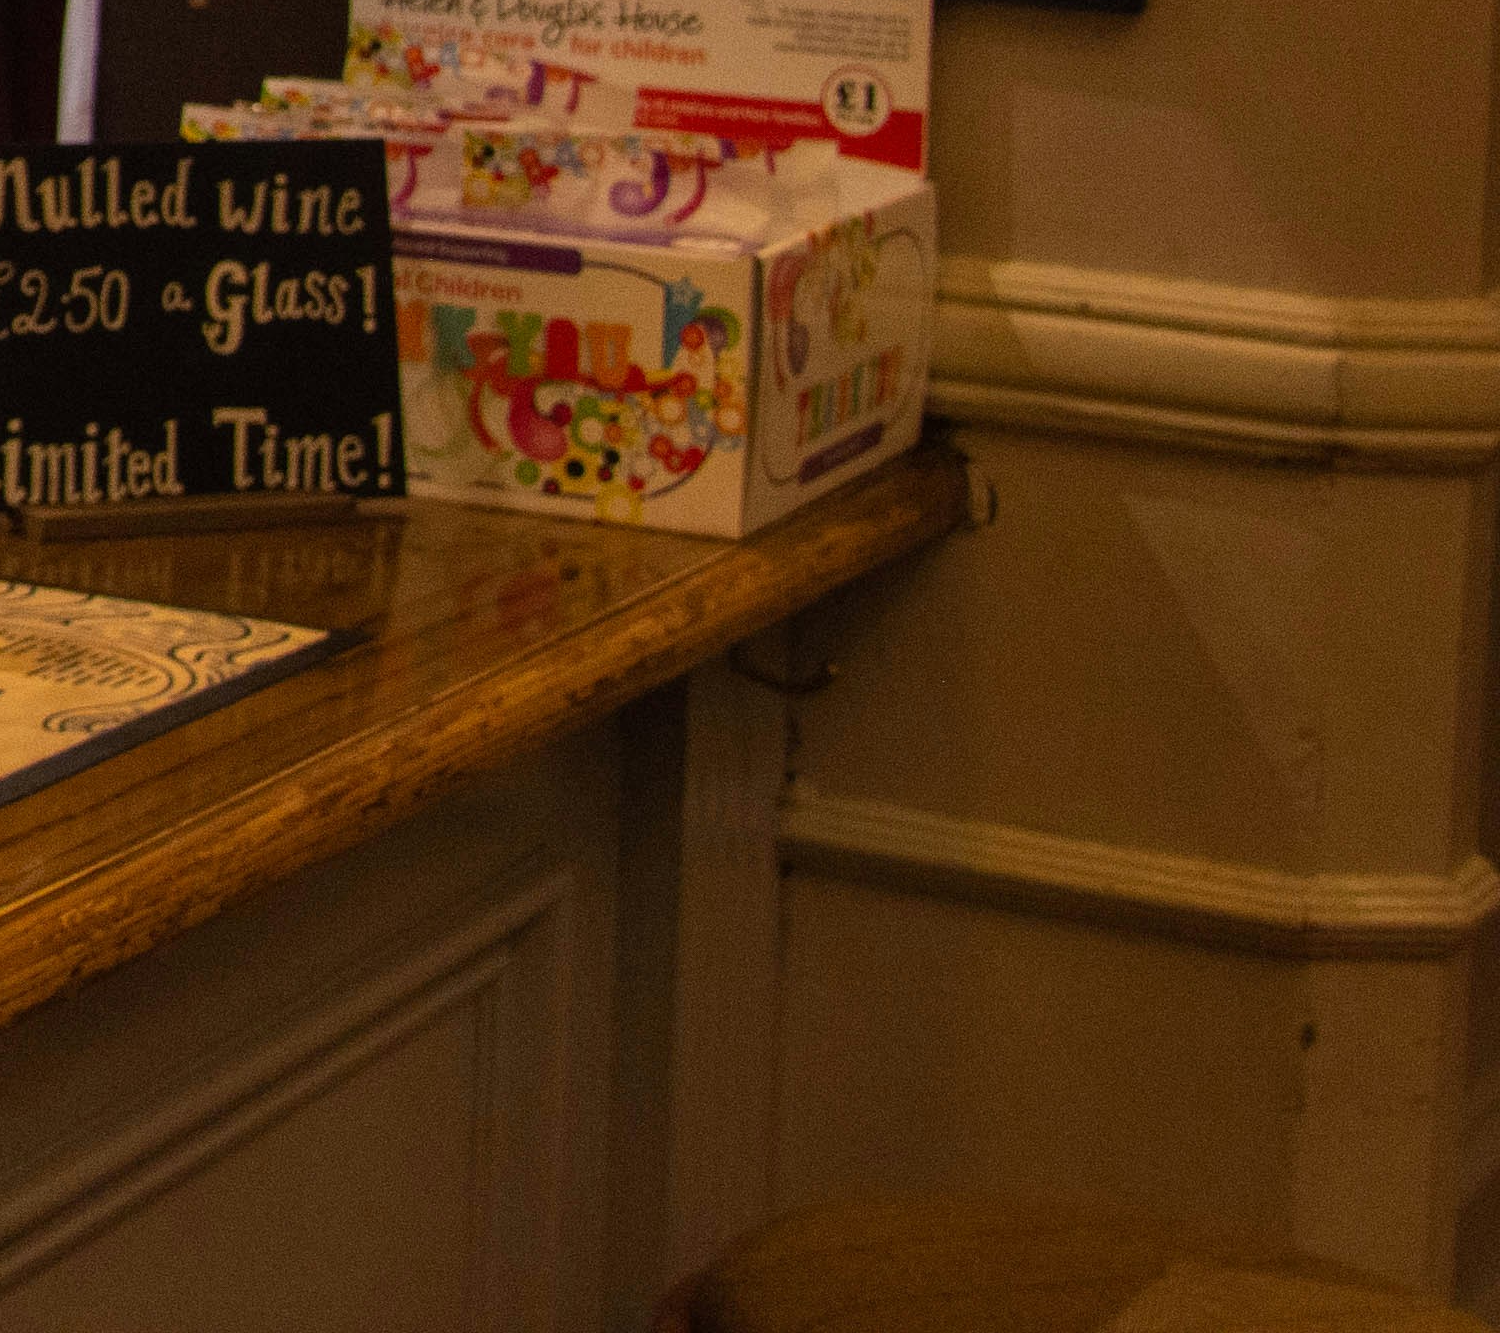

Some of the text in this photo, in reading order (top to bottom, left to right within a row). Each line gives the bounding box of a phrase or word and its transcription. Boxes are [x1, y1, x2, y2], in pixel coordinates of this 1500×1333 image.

[613, 0, 702, 34] House
[161, 280, 193, 313] a
[202, 258, 377, 355] Glass!
[211, 406, 393, 493] Time!
